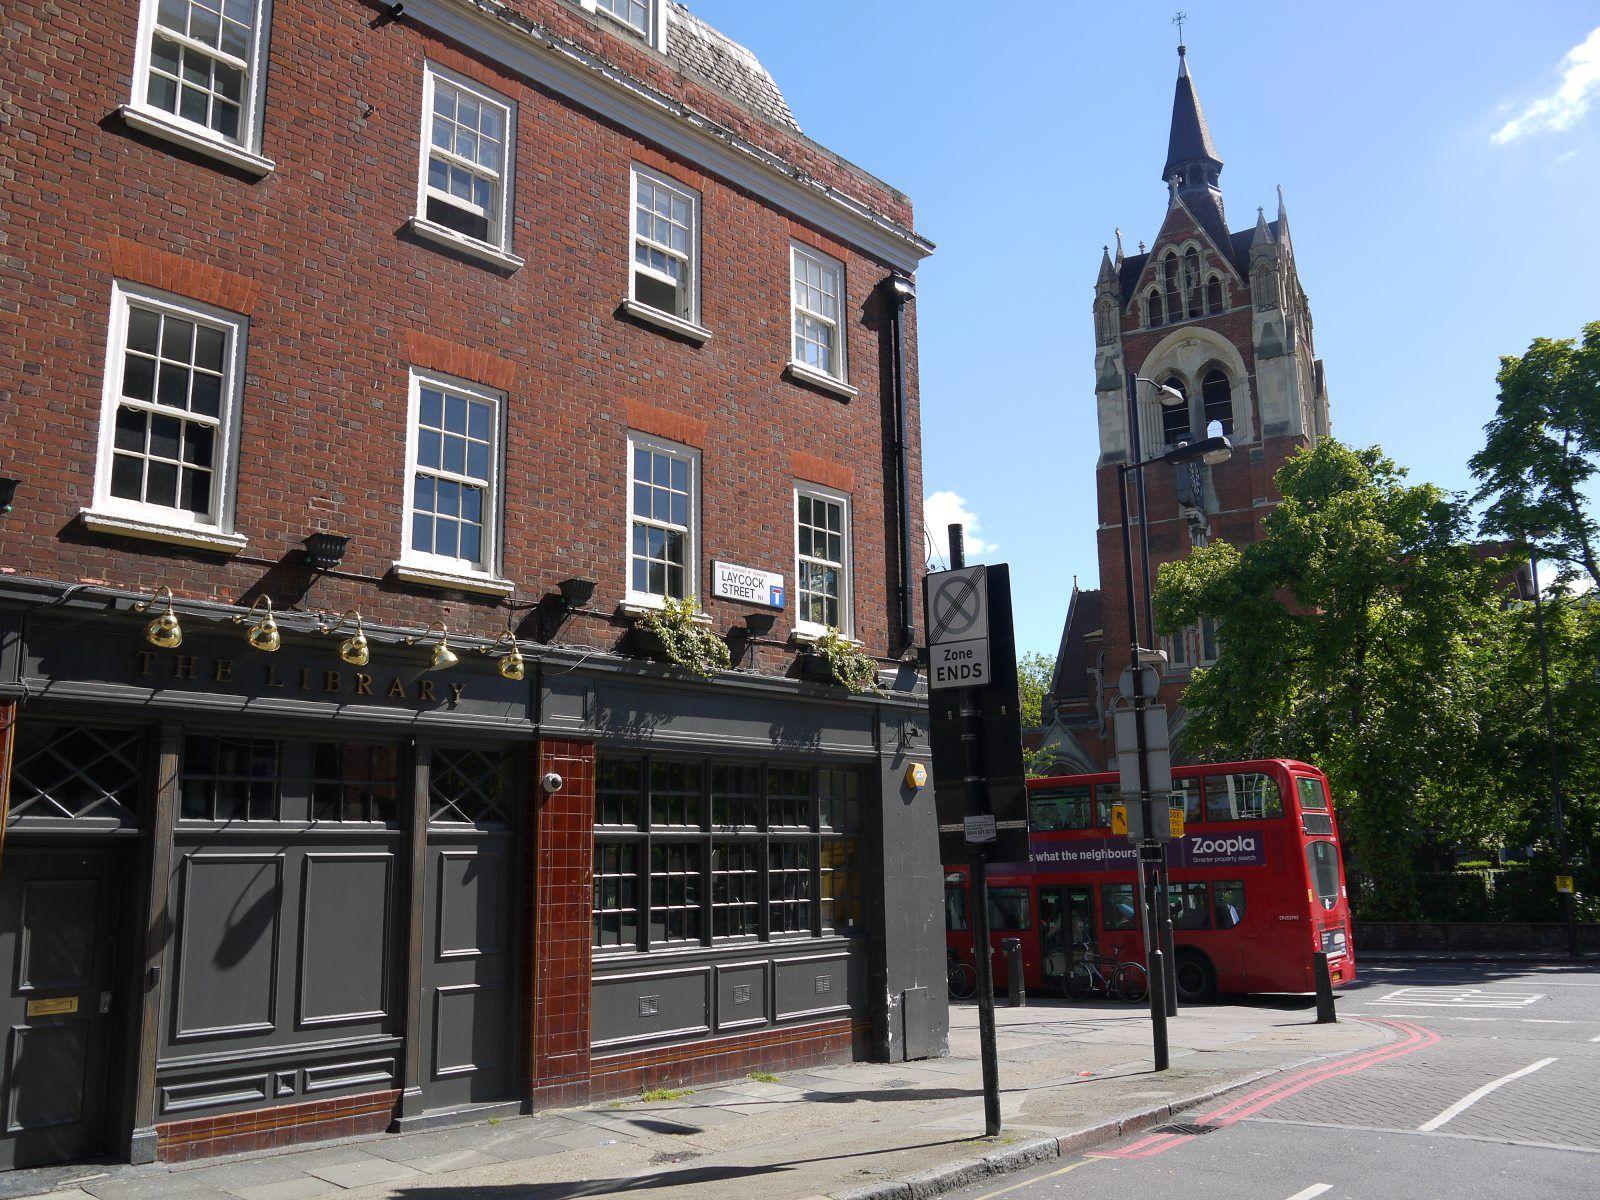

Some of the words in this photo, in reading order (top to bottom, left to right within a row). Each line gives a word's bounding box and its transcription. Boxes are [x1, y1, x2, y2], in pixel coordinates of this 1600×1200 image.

[721, 570, 765, 590] LAYCOCK
[722, 583, 756, 599] STREET
[944, 649, 973, 662] Zone
[136, 650, 235, 684] THE
[266, 663, 467, 704] LIBRARY
[937, 662, 982, 682] ENDS
[1036, 851, 1060, 862] what
[1061, 850, 1078, 861] the
[1080, 847, 1138, 861] neighbours
[1191, 835, 1256, 856] Zoopla
[1214, 855, 1237, 864] property
[1237, 854, 1257, 862] search
